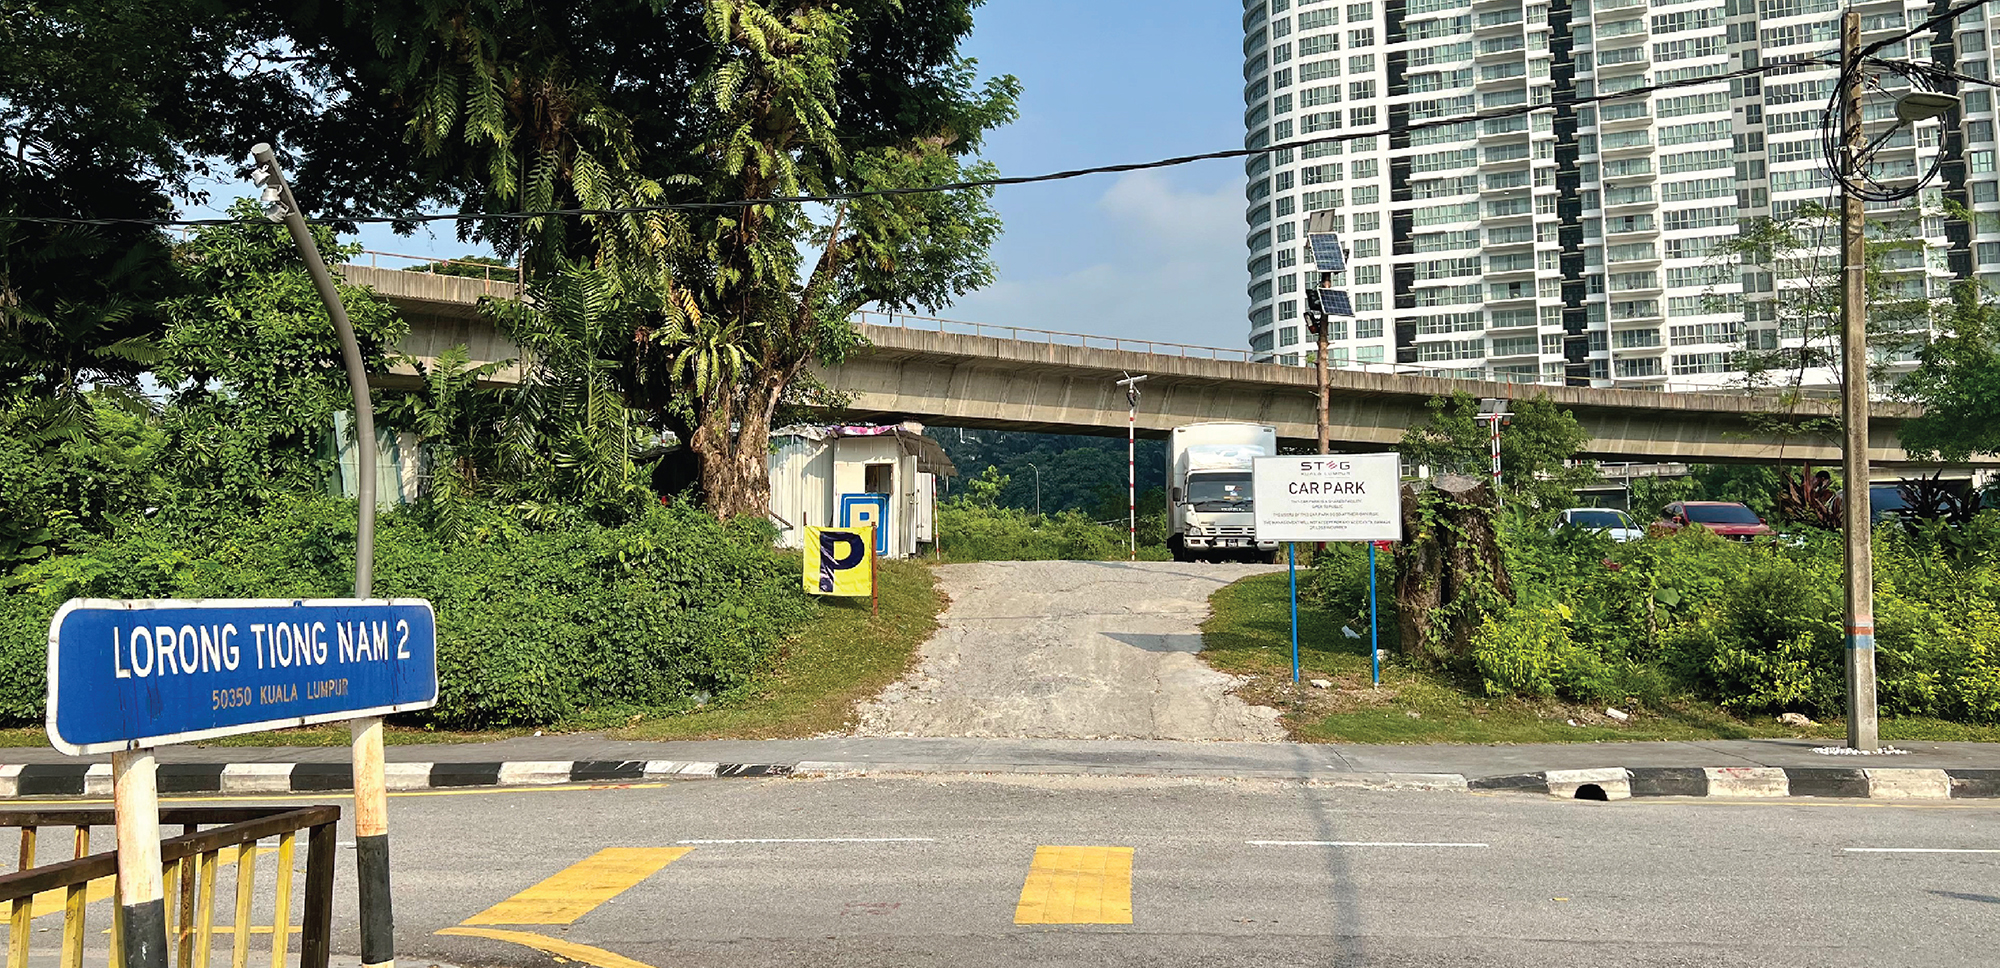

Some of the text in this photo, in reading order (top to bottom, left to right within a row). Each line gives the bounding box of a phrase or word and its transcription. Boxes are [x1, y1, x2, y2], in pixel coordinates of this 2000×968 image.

[1288, 481, 1366, 495] CAR PARK
[819, 531, 865, 593] P
[113, 619, 411, 679] LORONG TIONG NAM 2
[212, 678, 349, 711] 50350 KUALA LUMPUR
